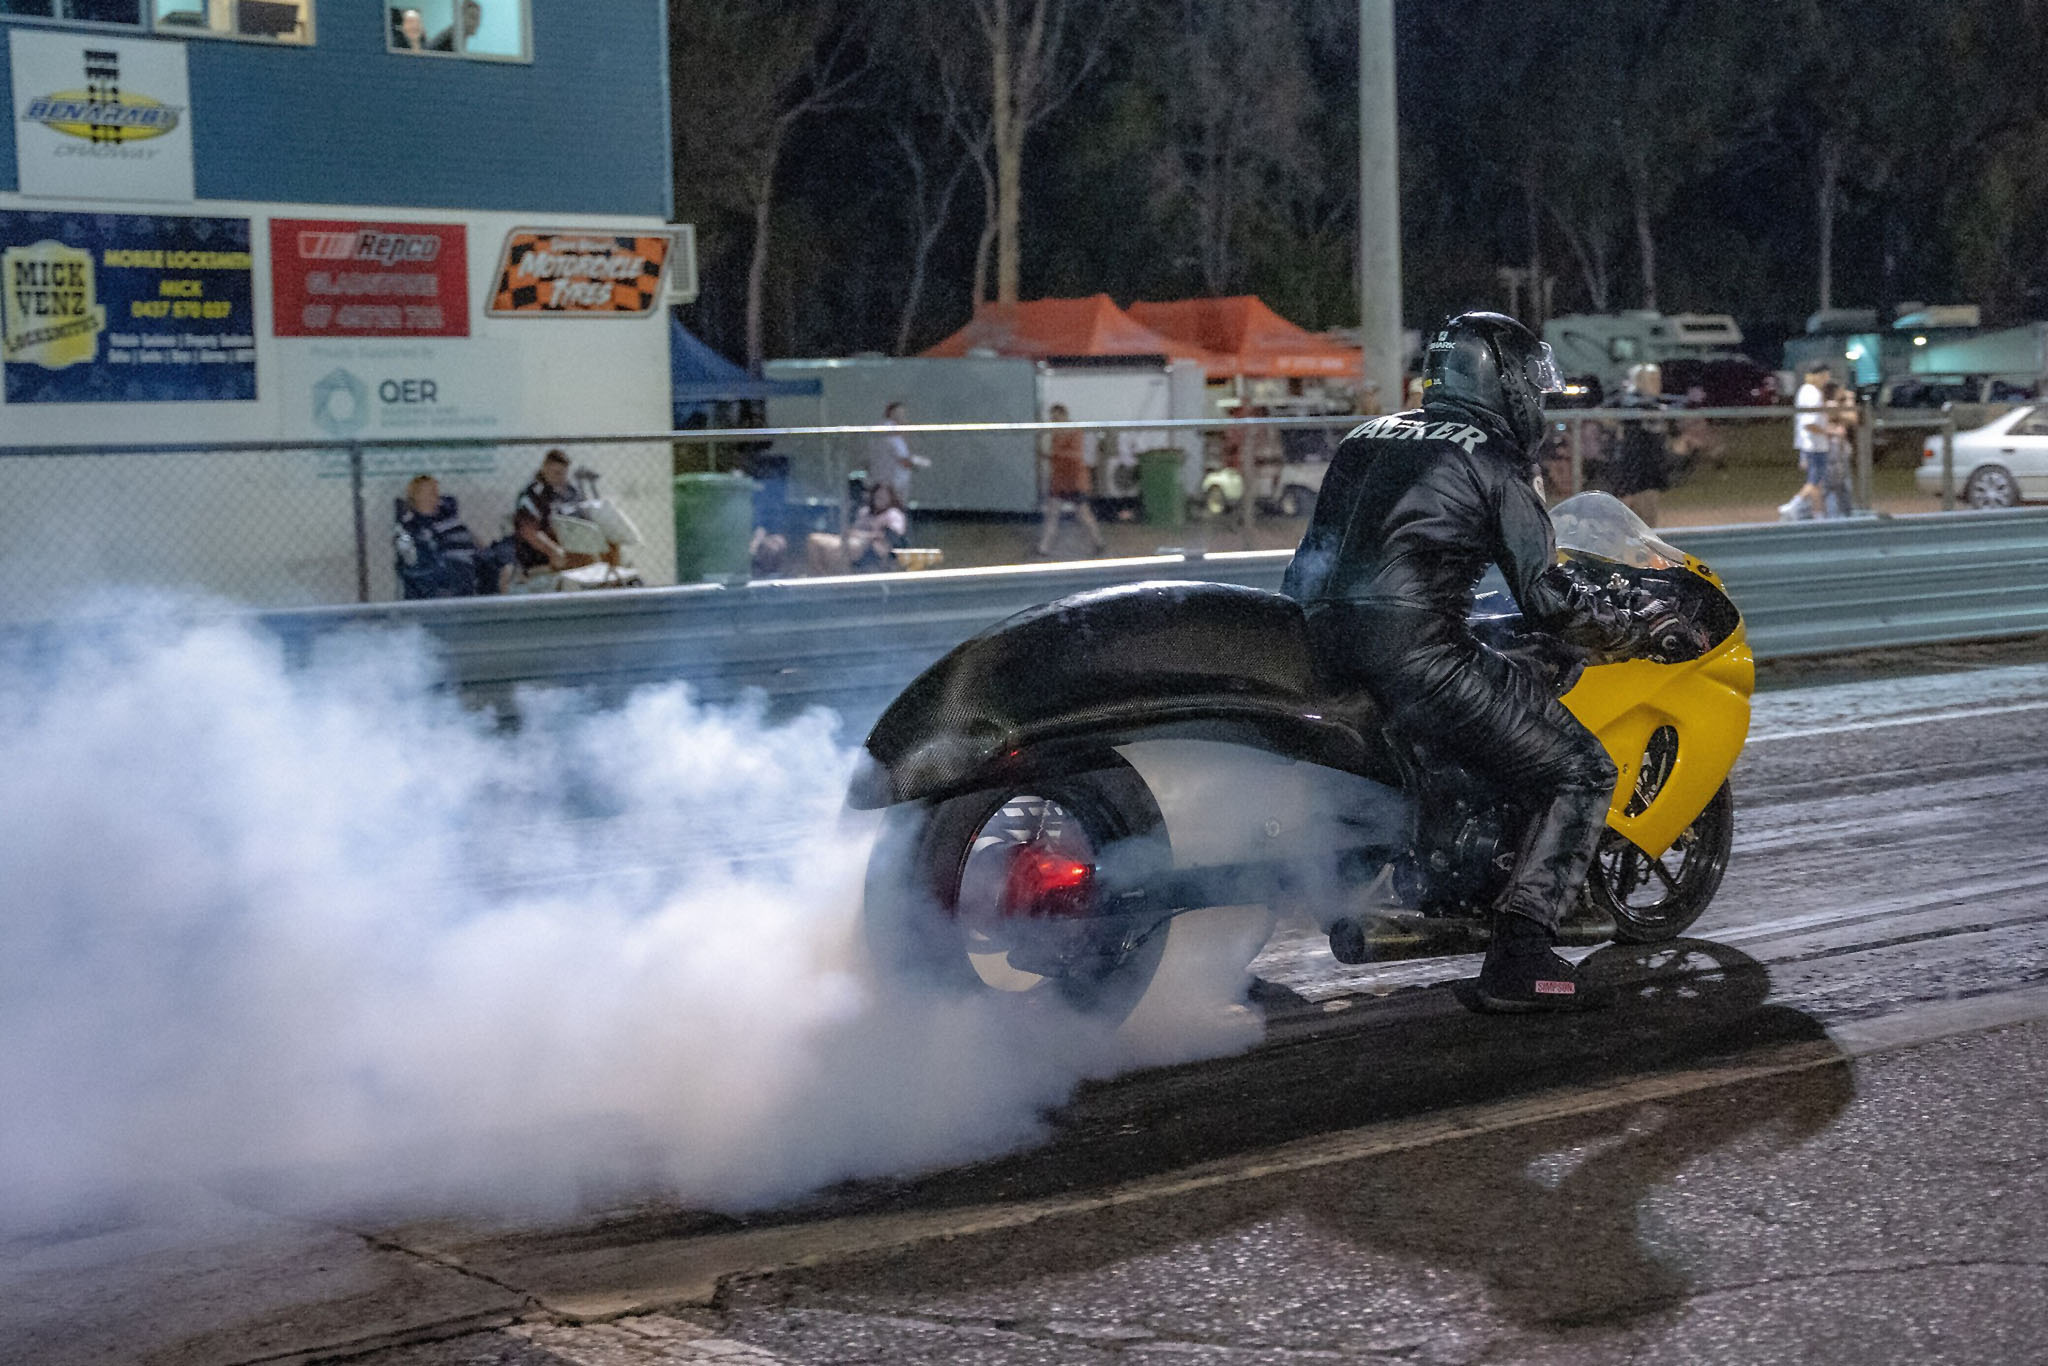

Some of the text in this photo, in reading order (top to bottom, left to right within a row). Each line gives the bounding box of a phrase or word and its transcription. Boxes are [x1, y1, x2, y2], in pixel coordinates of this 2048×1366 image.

[355, 230, 440, 263] Repco
[15, 261, 85, 286] MICK
[16, 290, 86, 317] VENZ
[1537, 981, 1574, 992] SIMPSON
